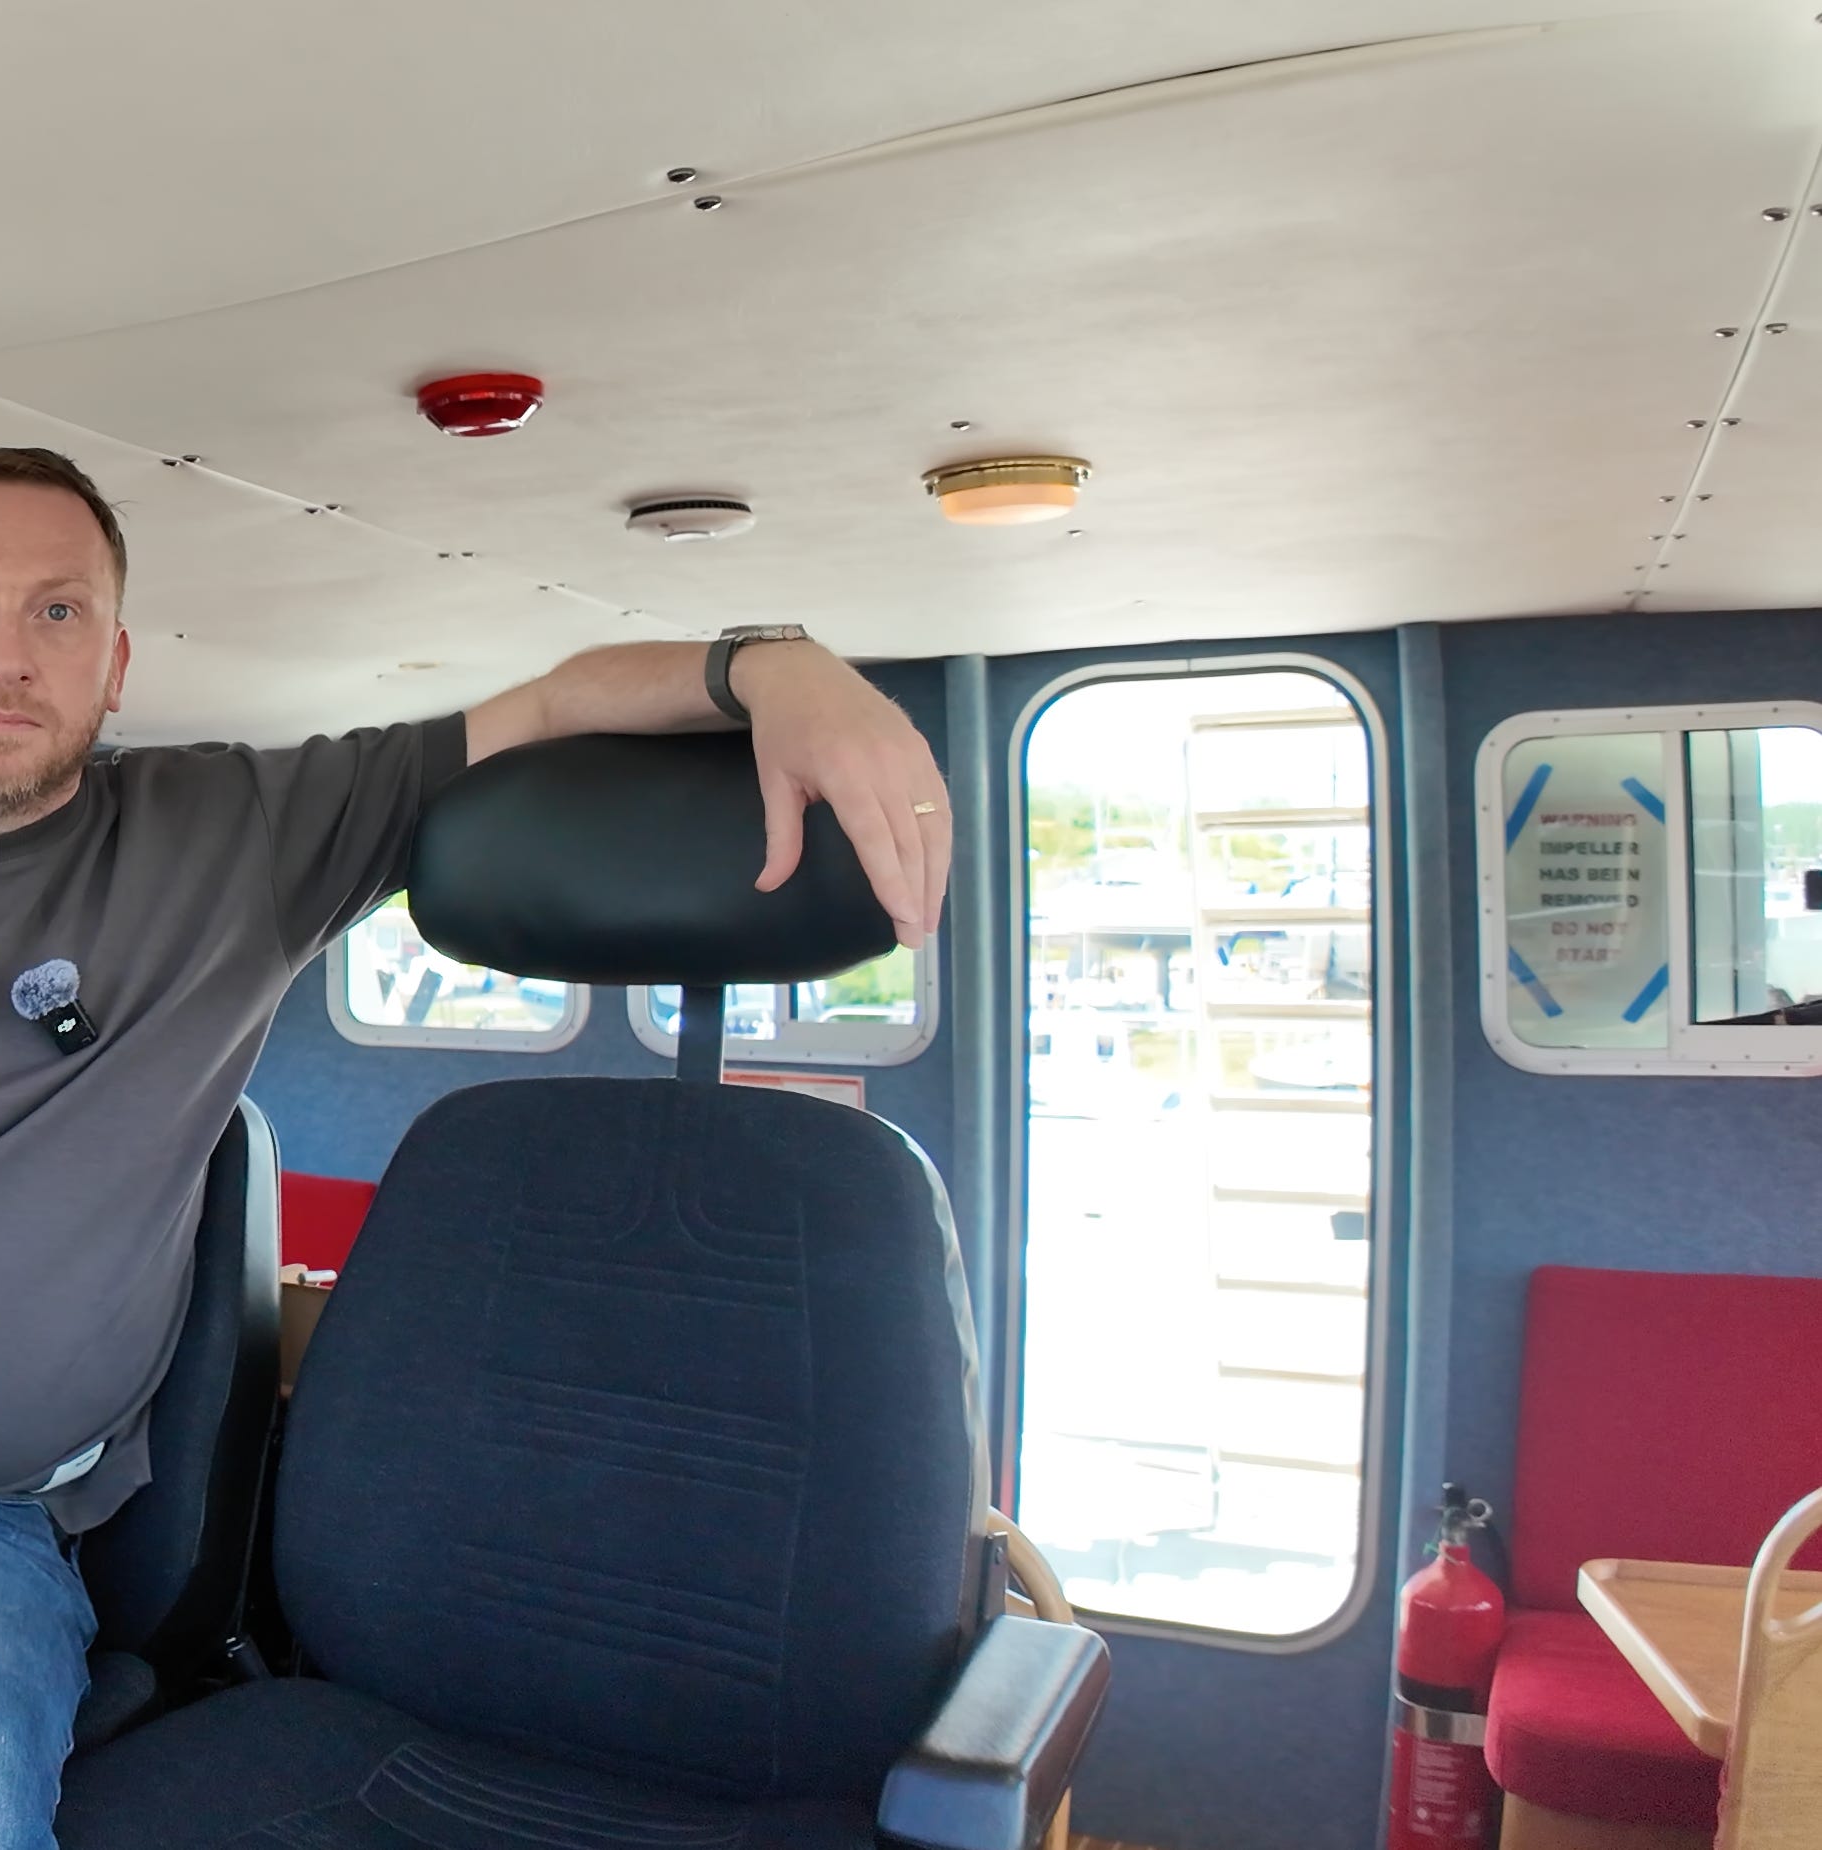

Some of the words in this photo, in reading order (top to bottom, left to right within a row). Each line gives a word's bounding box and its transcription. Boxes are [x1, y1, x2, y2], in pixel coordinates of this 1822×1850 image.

[1540, 841, 1640, 855] IMPELLER
[1539, 867, 1579, 881] HAS
[1587, 867, 1640, 881] BEEN
